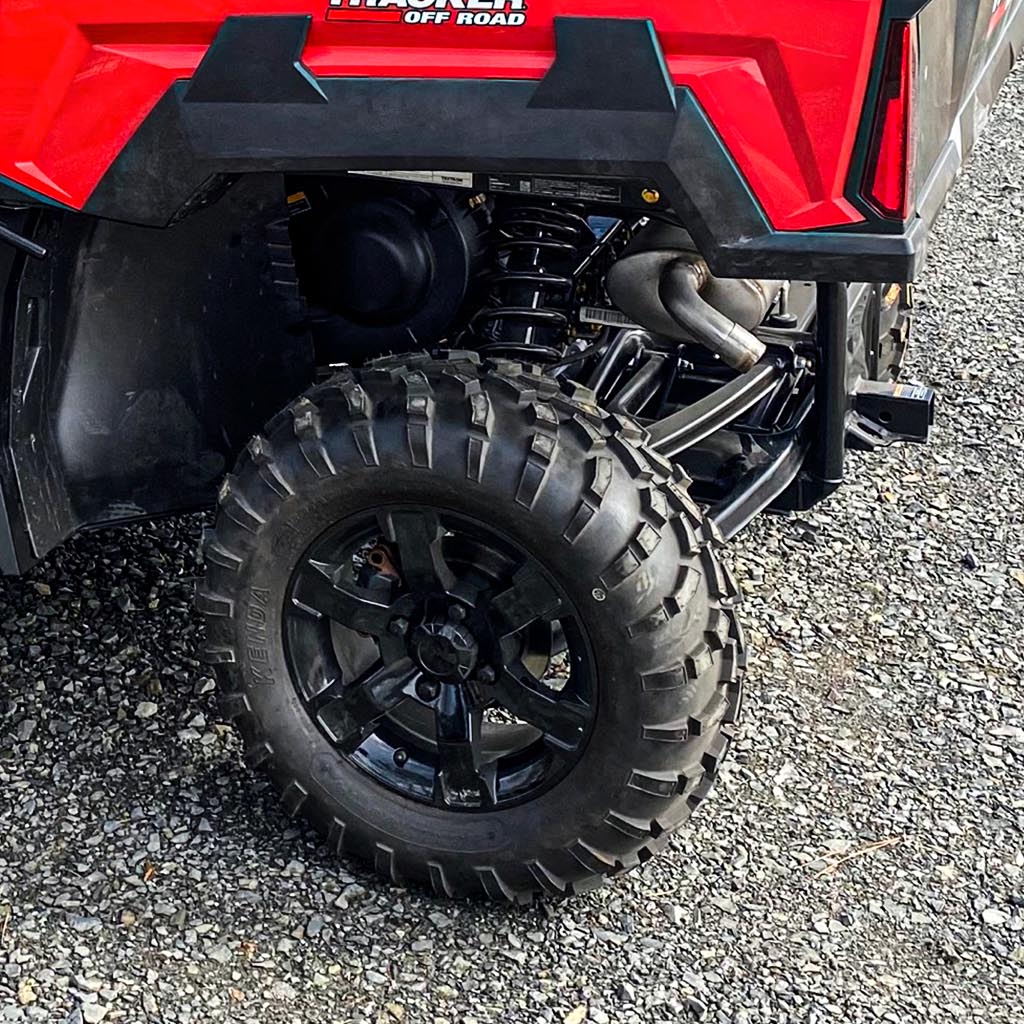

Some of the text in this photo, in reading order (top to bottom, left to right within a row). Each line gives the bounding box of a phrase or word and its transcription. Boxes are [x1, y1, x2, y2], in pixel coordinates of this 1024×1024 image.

[403, 10, 526, 26] OFF ROAD
[246, 585, 276, 688] KENDA
